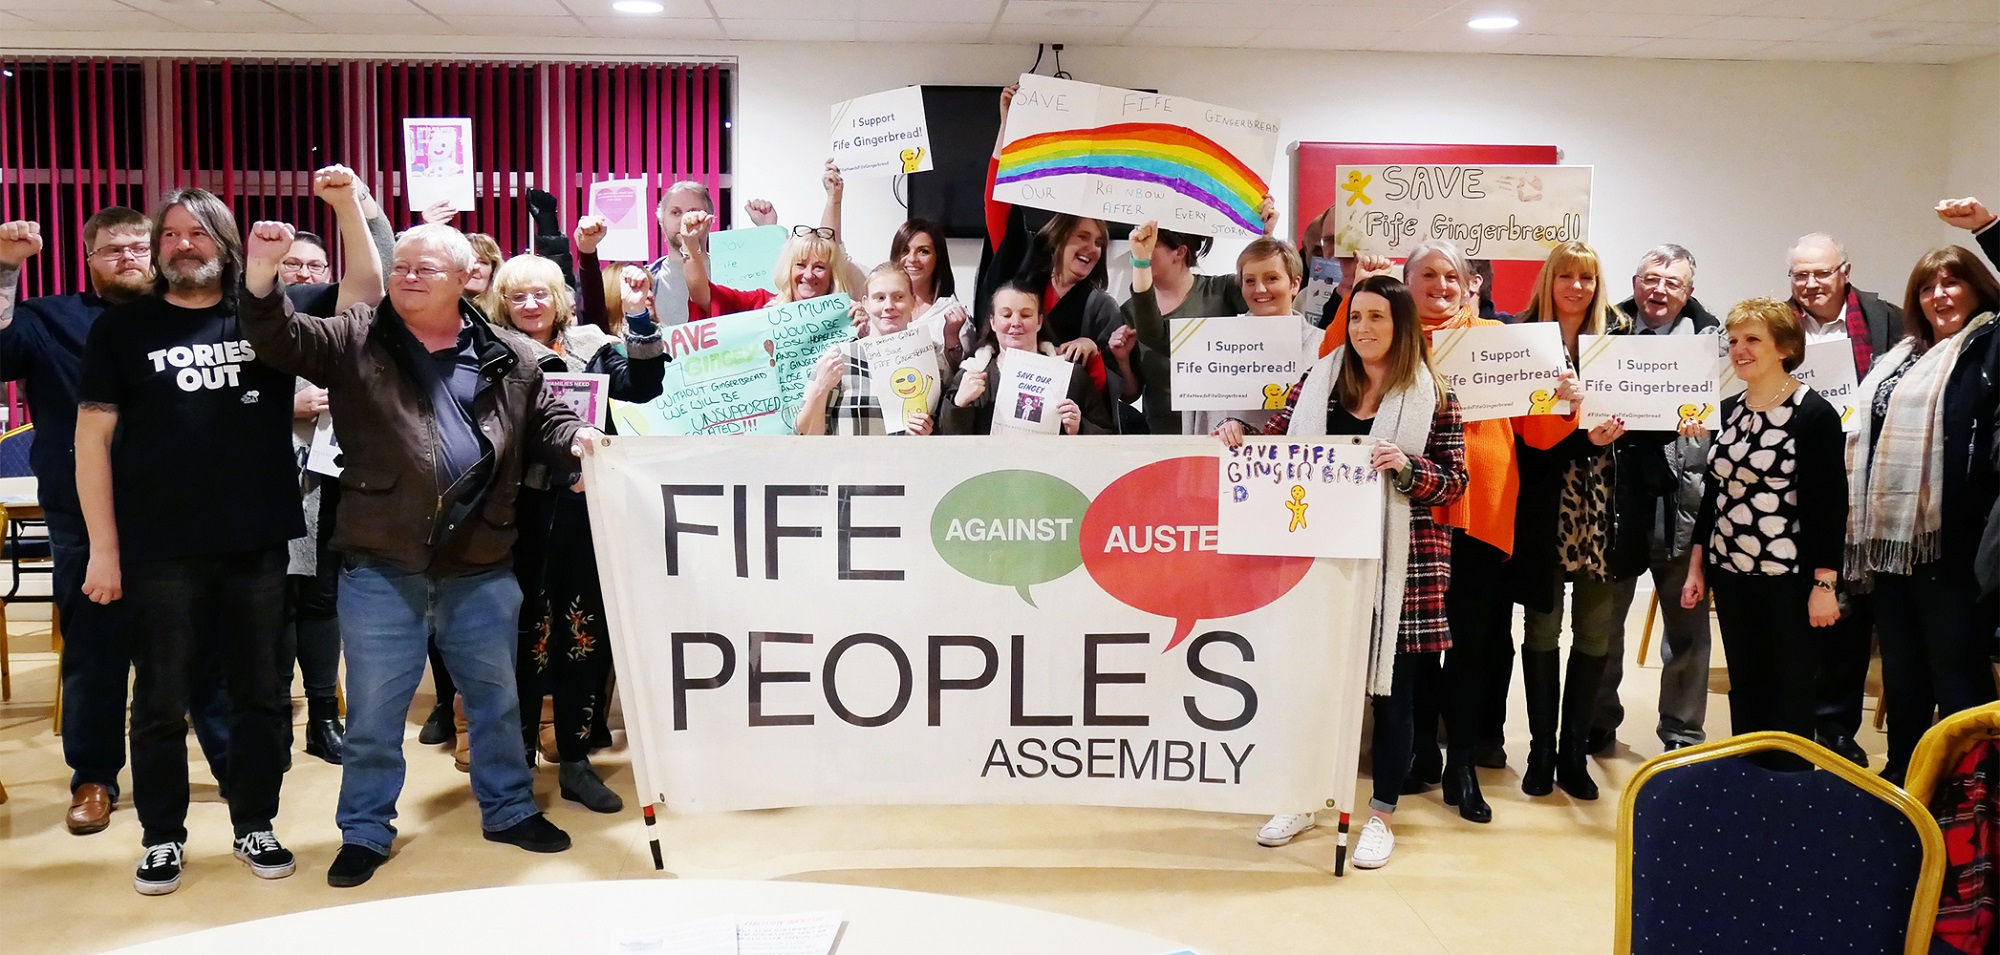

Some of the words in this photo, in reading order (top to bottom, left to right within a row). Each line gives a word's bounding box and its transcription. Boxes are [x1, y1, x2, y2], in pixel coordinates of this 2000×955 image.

[852, 119, 856, 128] I
[858, 113, 896, 128] Support
[1016, 87, 1070, 113] SAVE
[1121, 93, 1173, 116] FIFE
[1205, 108, 1279, 134] GINGERBREAD
[832, 139, 851, 152] Fife
[853, 126, 923, 148] Gingerbread!
[1021, 184, 1056, 201] OUR
[1096, 179, 1166, 200] RANBOW
[1383, 166, 1486, 201] SAVE
[1102, 201, 1145, 215] AFTER
[1175, 207, 1207, 222] EVERY
[1211, 223, 1248, 237] STORM
[1365, 211, 1418, 247] Fife
[1430, 213, 1580, 257] Gingerbread!
[767, 307, 792, 326] US
[798, 298, 845, 318] MUMS
[773, 323, 819, 340] WOULD
[821, 319, 839, 331] BE
[809, 329, 848, 345] HOPELESS
[147, 339, 257, 373] TORIES
[775, 351, 798, 362] AND
[1207, 341, 1211, 351] I
[1215, 341, 1264, 354] Support
[1471, 352, 1475, 362] I
[1480, 348, 1531, 362] Support
[778, 363, 785, 374] IF
[873, 359, 893, 371] FIFE
[1176, 362, 1202, 374] Fife
[1208, 361, 1296, 376] Gingerbread!
[1618, 359, 1621, 370] I
[1626, 359, 1678, 373] Support
[176, 364, 241, 393] OUT
[780, 372, 803, 384] LOSE
[781, 383, 805, 393] AND
[1016, 371, 1035, 381] SAVE
[1035, 375, 1052, 385] OUR
[1018, 382, 1045, 394] GINGEY
[1585, 380, 1613, 392] Fife
[1618, 380, 1713, 396] Gingerbread!
[656, 385, 708, 410] WITHOUT
[663, 404, 688, 420] WE
[690, 397, 720, 410] WILL
[721, 391, 740, 403] BE
[691, 396, 781, 431] UNSUPPORTED
[1229, 445, 1278, 460] SAVE
[660, 484, 906, 581] FIFE
[945, 517, 1073, 542] AGAINST
[1104, 525, 1218, 553] AUSTE
[980, 737, 1256, 785] ASSEMBLY
